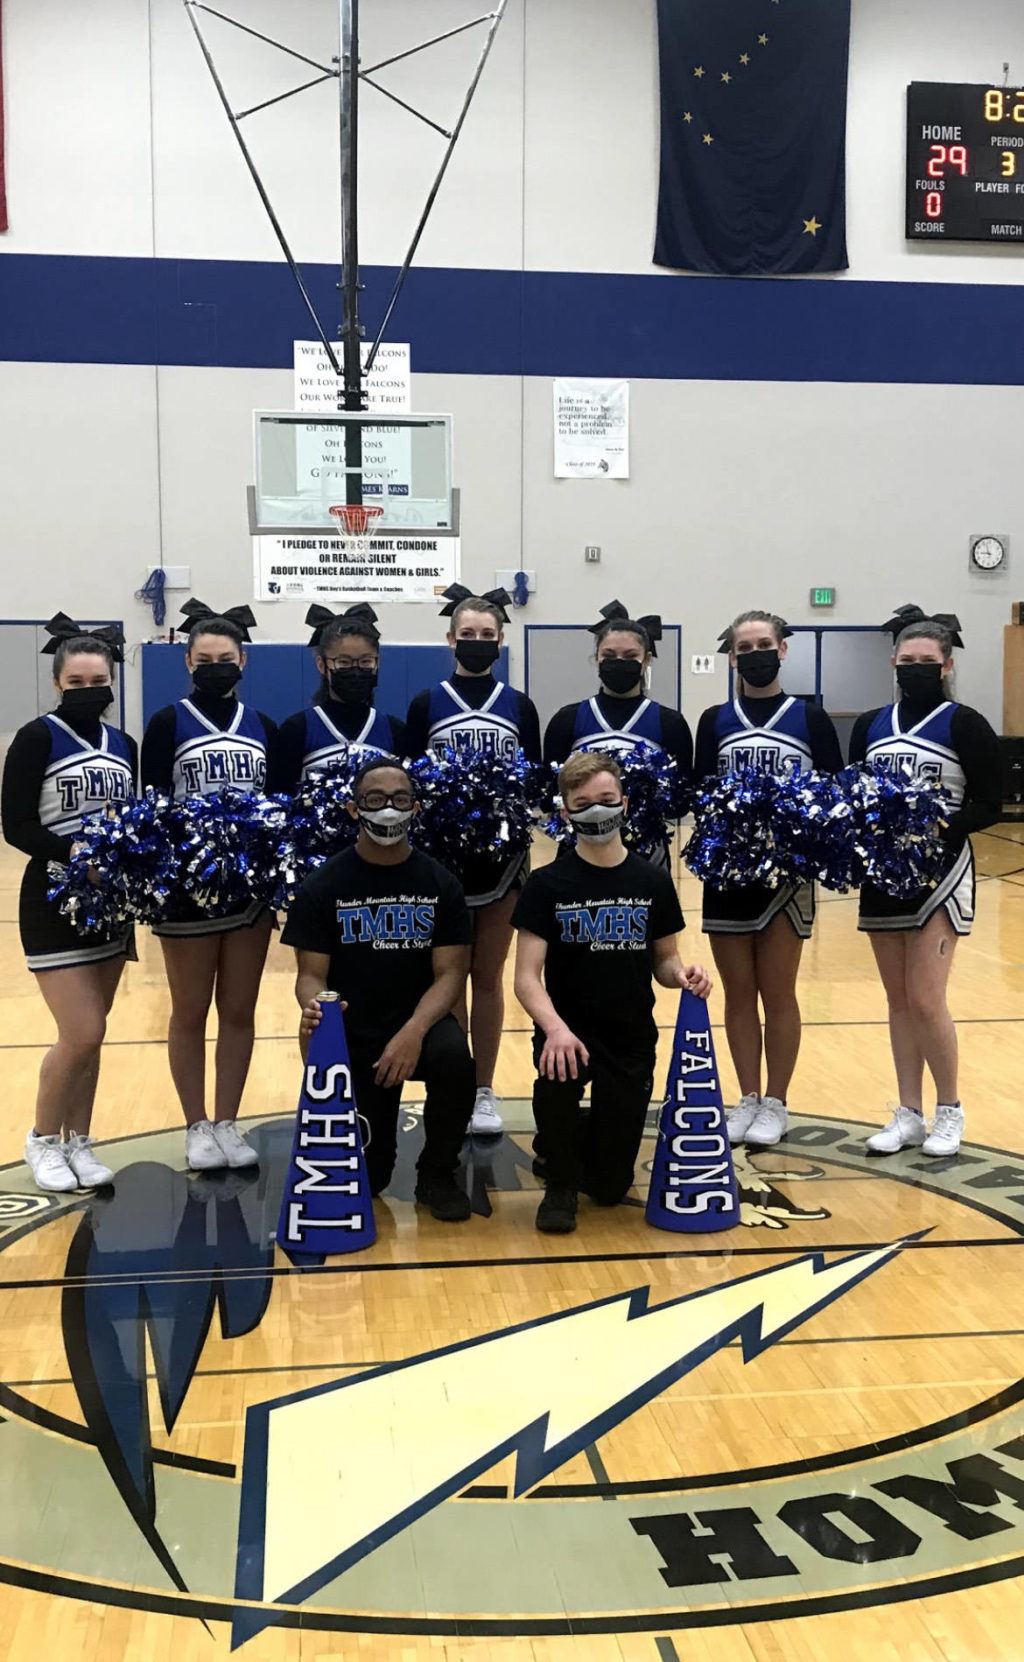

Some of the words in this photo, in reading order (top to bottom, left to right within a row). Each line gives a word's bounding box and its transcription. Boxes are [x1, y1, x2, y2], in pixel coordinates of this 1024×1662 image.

[922, 125, 962, 141] HOME
[991, 136, 1024, 147] PERIOD
[928, 145, 967, 176] 29
[1001, 151, 1015, 176] 3
[915, 179, 945, 190] FOULS
[975, 182, 1010, 193] PLAYER
[926, 191, 941, 217] 0
[914, 221, 945, 233] SCORE
[991, 224, 1023, 235] MATCH
[317, 378, 340, 386] LOVE
[366, 379, 406, 389] FALCONS
[321, 424, 346, 433] SILVE
[580, 420, 613, 429] problem
[287, 540, 317, 549] PLEDGE
[318, 540, 329, 549] TO
[396, 541, 438, 551] CONDONE
[319, 553, 331, 563] OR
[367, 554, 397, 563] SILENT
[270, 566, 298, 576] ABOUT
[299, 566, 337, 576] VIOLENCE
[339, 567, 374, 576] AGAINST
[375, 567, 406, 577] WOMEN
[408, 568, 415, 577] &
[56, 766, 133, 812] TMH
[363, 896, 397, 906] Mountain
[398, 894, 416, 905] High
[416, 895, 439, 905] School
[583, 899, 616, 909] Mountain
[616, 897, 633, 908] High
[634, 897, 653, 906] School
[337, 904, 435, 945] TMHS
[555, 905, 649, 943] TMHS
[372, 939, 400, 951] Cheer
[401, 938, 411, 950] &
[590, 941, 615, 952] Cheer
[664, 1029, 735, 1215] FALCONS
[287, 1063, 363, 1242] TMHS
[628, 1434, 1024, 1589] HOM
